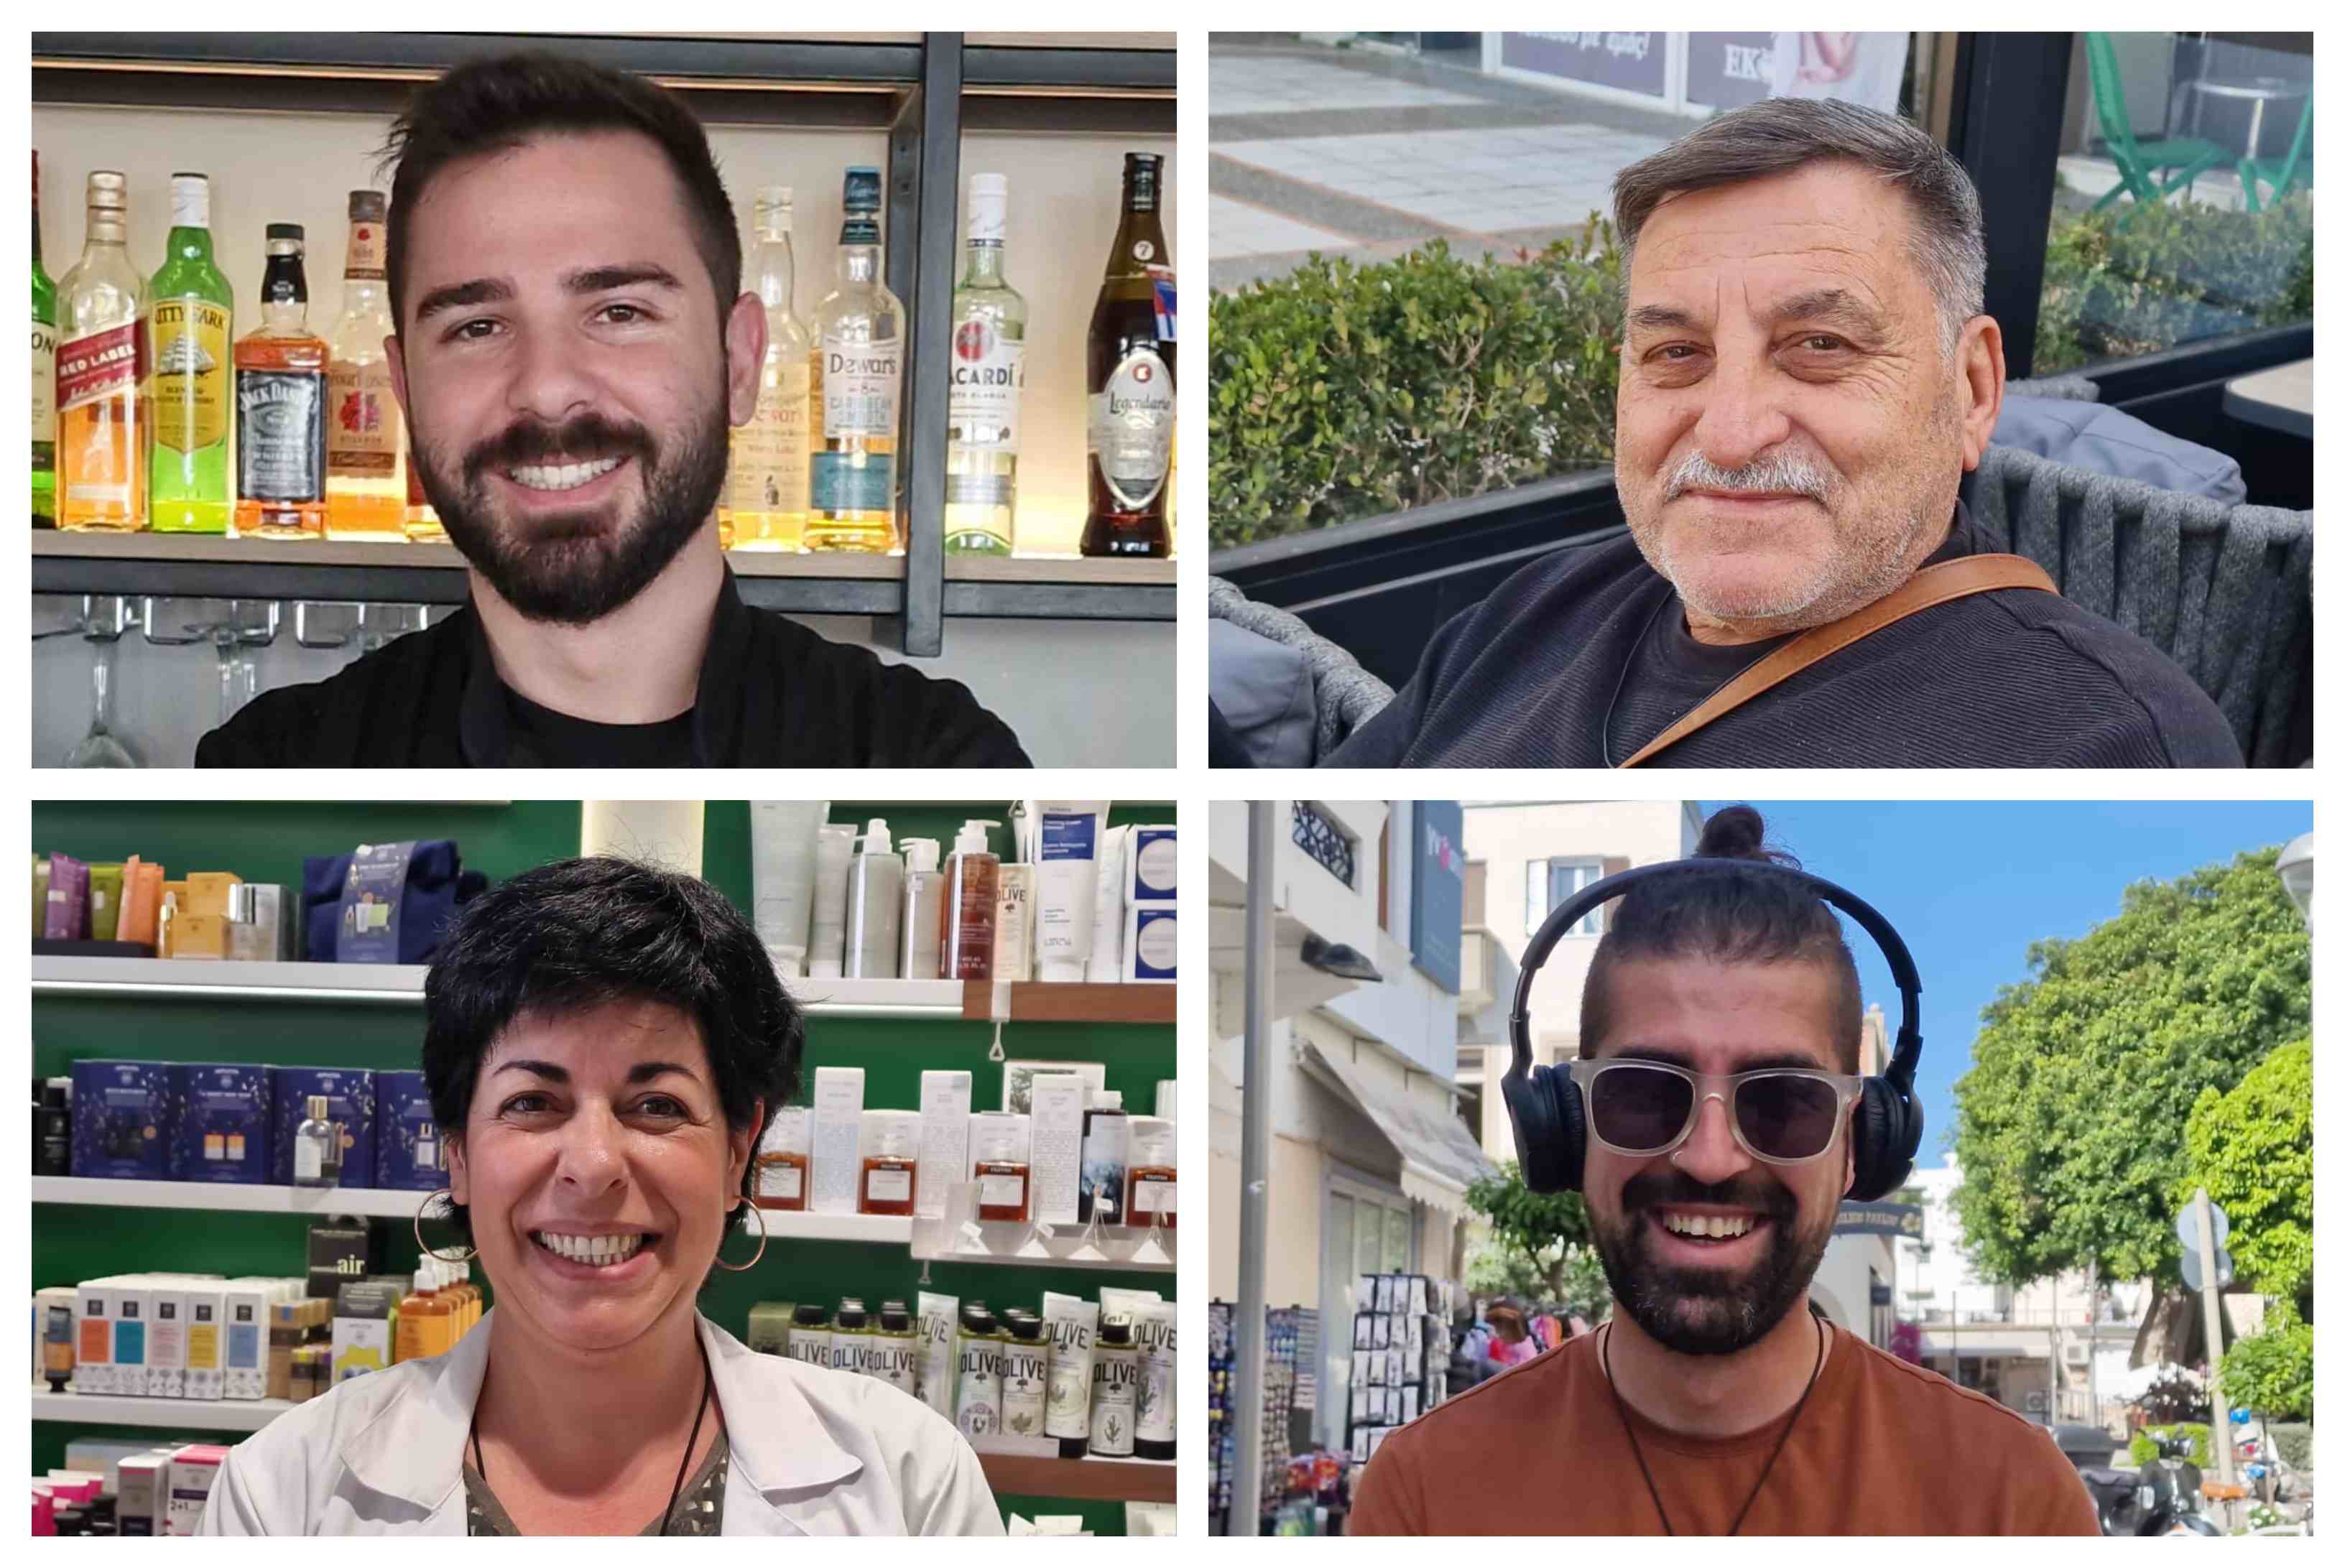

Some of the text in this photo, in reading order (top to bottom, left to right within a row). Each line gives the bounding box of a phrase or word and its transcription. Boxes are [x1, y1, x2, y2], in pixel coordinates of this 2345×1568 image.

[59, 343, 136, 376] RED LABEL
[336, 1254, 365, 1275] air
[916, 1316, 948, 1343] OLIVE
[1043, 1321, 1089, 1350] OLIVE
[1134, 1323, 1177, 1351] OLIVE
[833, 1349, 873, 1369] OLIVE
[873, 1351, 915, 1373] OLIVE
[961, 1353, 1002, 1376] OLIVE
[1002, 1358, 1045, 1381] OLIVE
[1093, 1362, 1137, 1386] OLIVE
